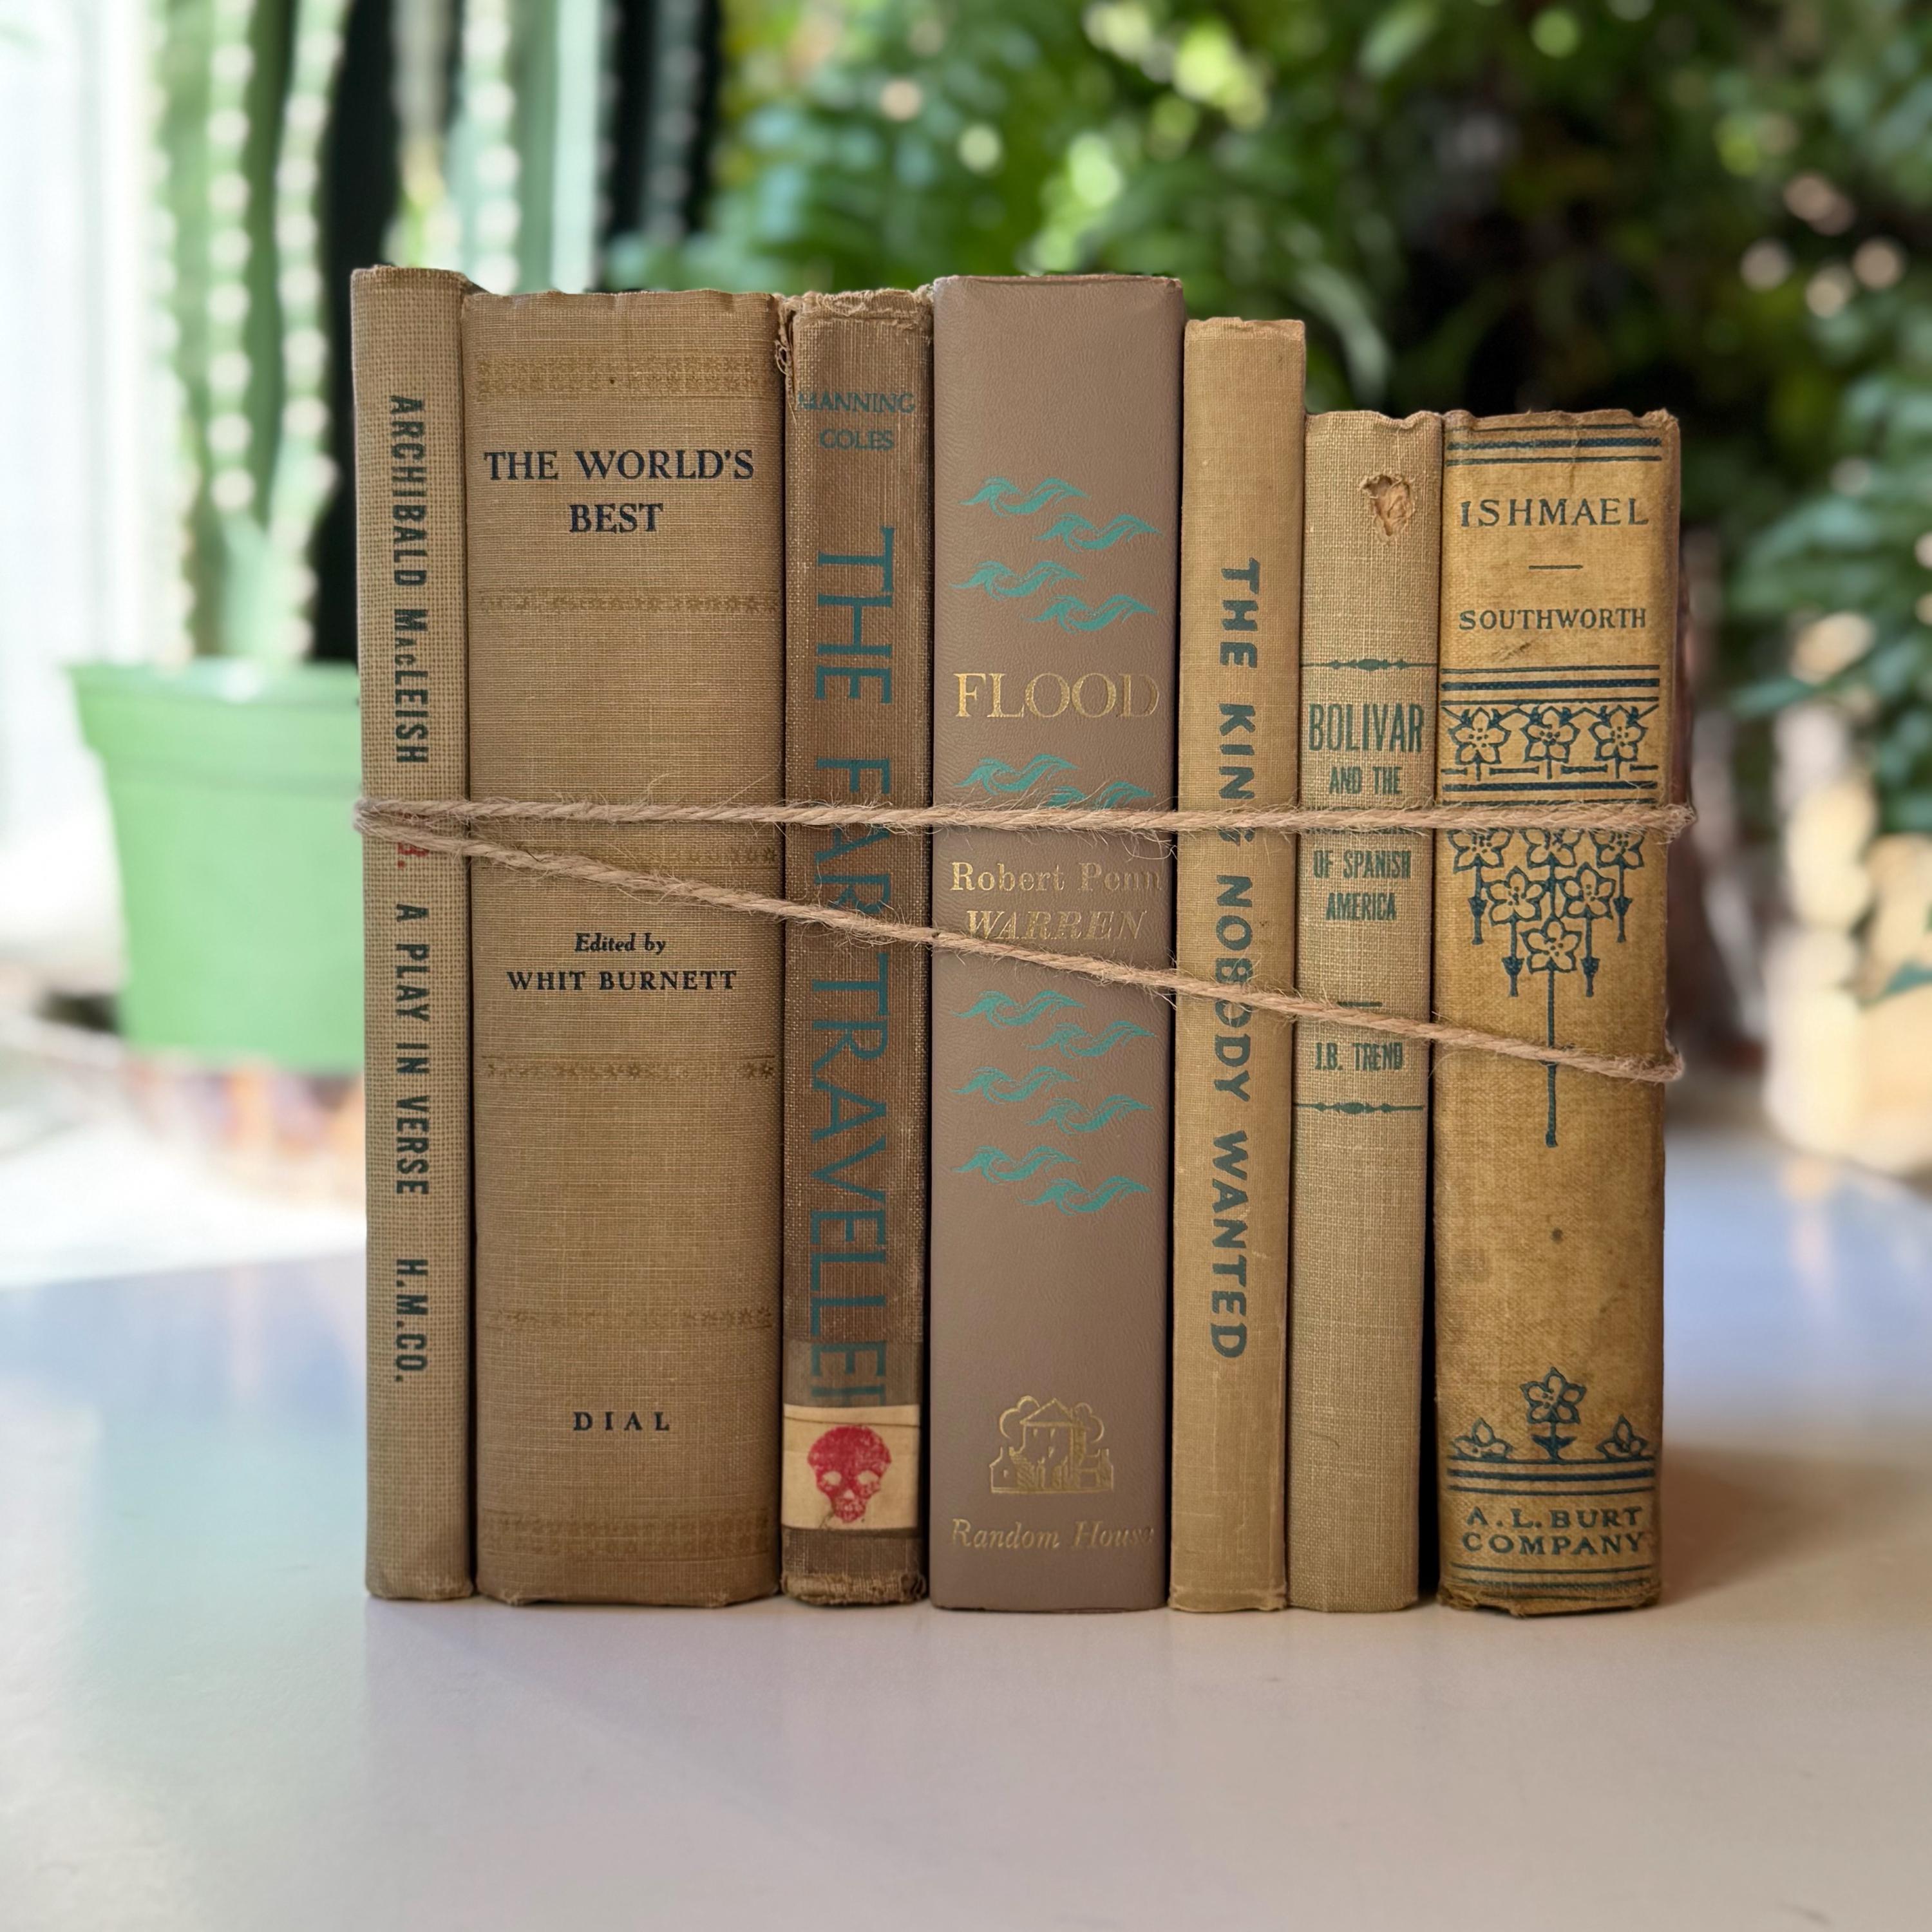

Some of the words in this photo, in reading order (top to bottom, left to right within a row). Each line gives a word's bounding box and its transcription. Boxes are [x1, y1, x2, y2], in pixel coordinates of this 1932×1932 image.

[797, 391, 915, 413] MANNING
[819, 428, 895, 451] COLES
[484, 450, 558, 480] THE
[575, 450, 755, 480] WORLD'S
[390, 395, 428, 587] ARCHIBALD
[569, 503, 663, 533] BEST
[1460, 497, 1650, 528] ISHMAEL
[815, 526, 895, 703] THE
[1220, 558, 1260, 668] THE
[1458, 608, 1647, 630] SOUTHWORTH
[953, 672, 1159, 718] FLOOD
[1309, 703, 1425, 752] BOLIVAR
[1329, 766, 1362, 794] AND
[1372, 766, 1403, 794] THE
[950, 862, 1065, 891] Robert
[1078, 862, 1162, 891] Penn
[1313, 850, 1334, 878] OF
[1343, 850, 1412, 879] SPANISH
[395, 903, 430, 922] A
[1325, 893, 1397, 920] AMERICA
[967, 910, 1148, 940] WARREN
[574, 933, 636, 952] Edited
[644, 933, 666, 955] by
[395, 943, 430, 1023] PLAY
[507, 971, 585, 990] WHIT
[599, 971, 737, 990] BURNETT
[1214, 875, 1253, 1102] NOBODY
[395, 1043, 430, 1074] IN
[1352, 1042, 1403, 1071] TREND
[395, 1095, 430, 1195] VERSE
[1211, 1130, 1249, 1358] WANTED
[573, 1412, 670, 1431] DIAL
[952, 1518, 1061, 1549] Random
[1074, 1520, 1155, 1548] House
[1462, 1531, 1645, 1555] COMPANY
